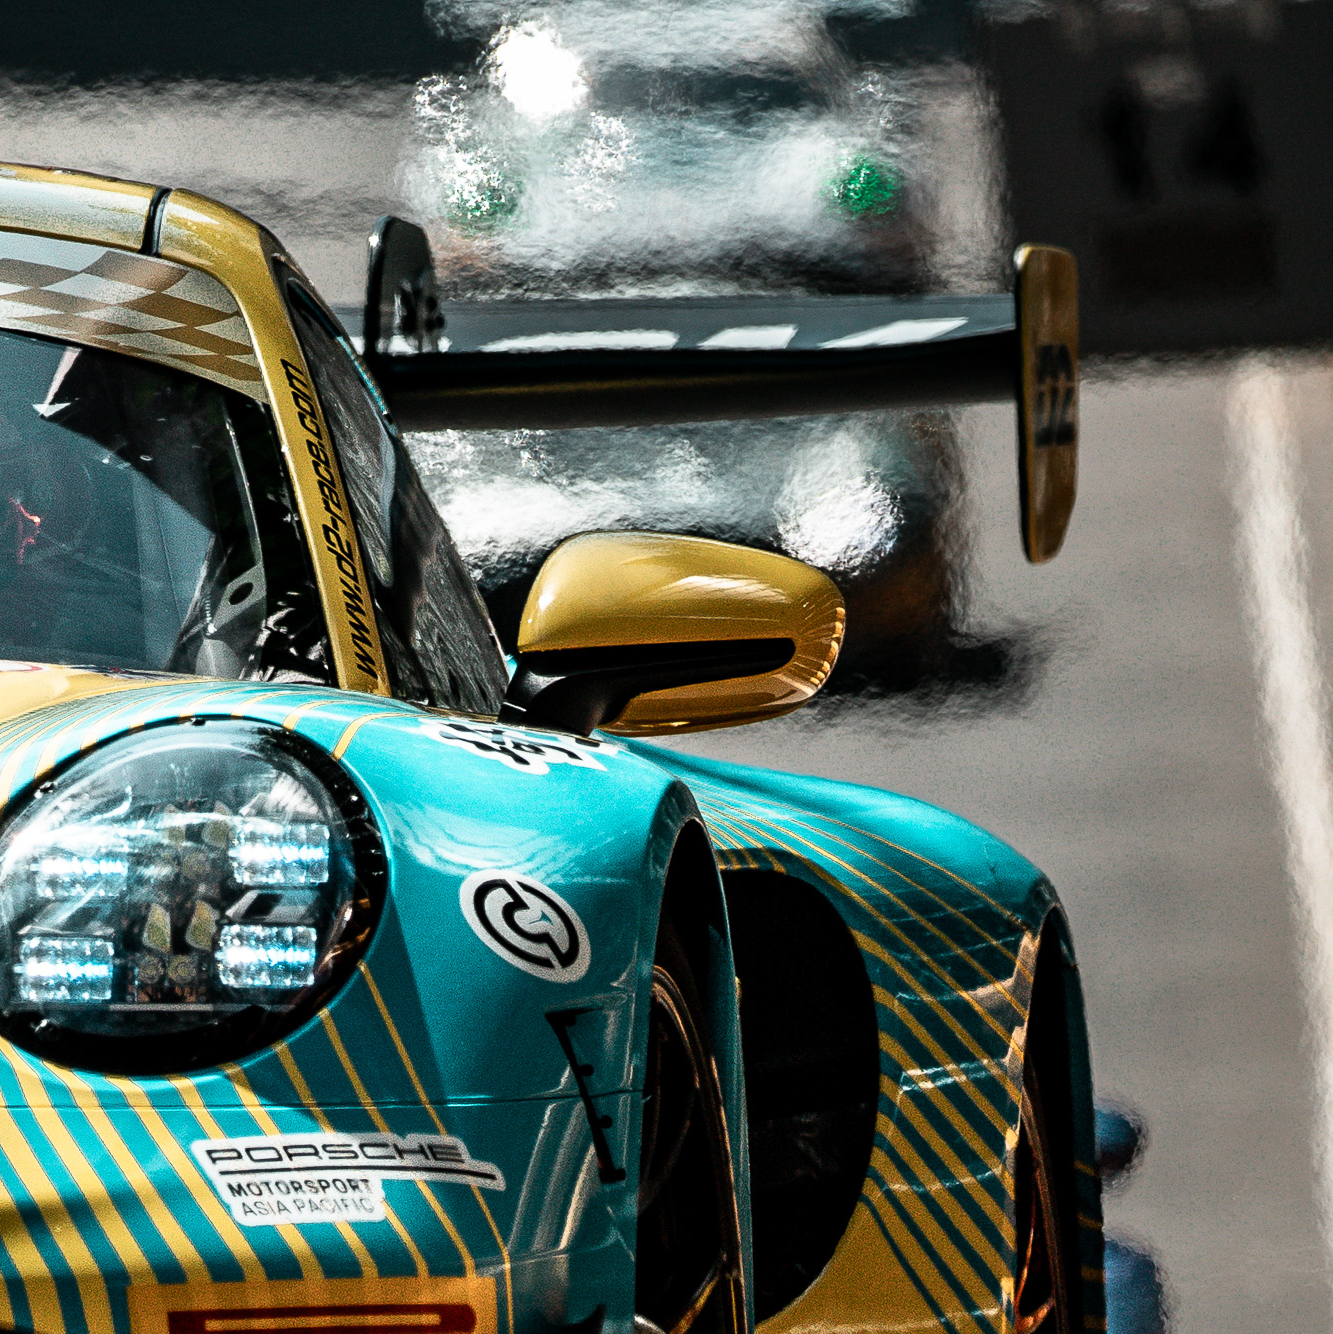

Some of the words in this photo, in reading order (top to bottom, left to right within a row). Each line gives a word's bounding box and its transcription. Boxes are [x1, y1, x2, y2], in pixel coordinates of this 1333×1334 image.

[280, 359, 379, 679] www.d2-race.com
[205, 1142, 466, 1165] PORSCHE
[227, 1178, 371, 1198] MOTORSPORT
[241, 1201, 291, 1217] ASIA
[296, 1197, 375, 1214] PACIFIC
